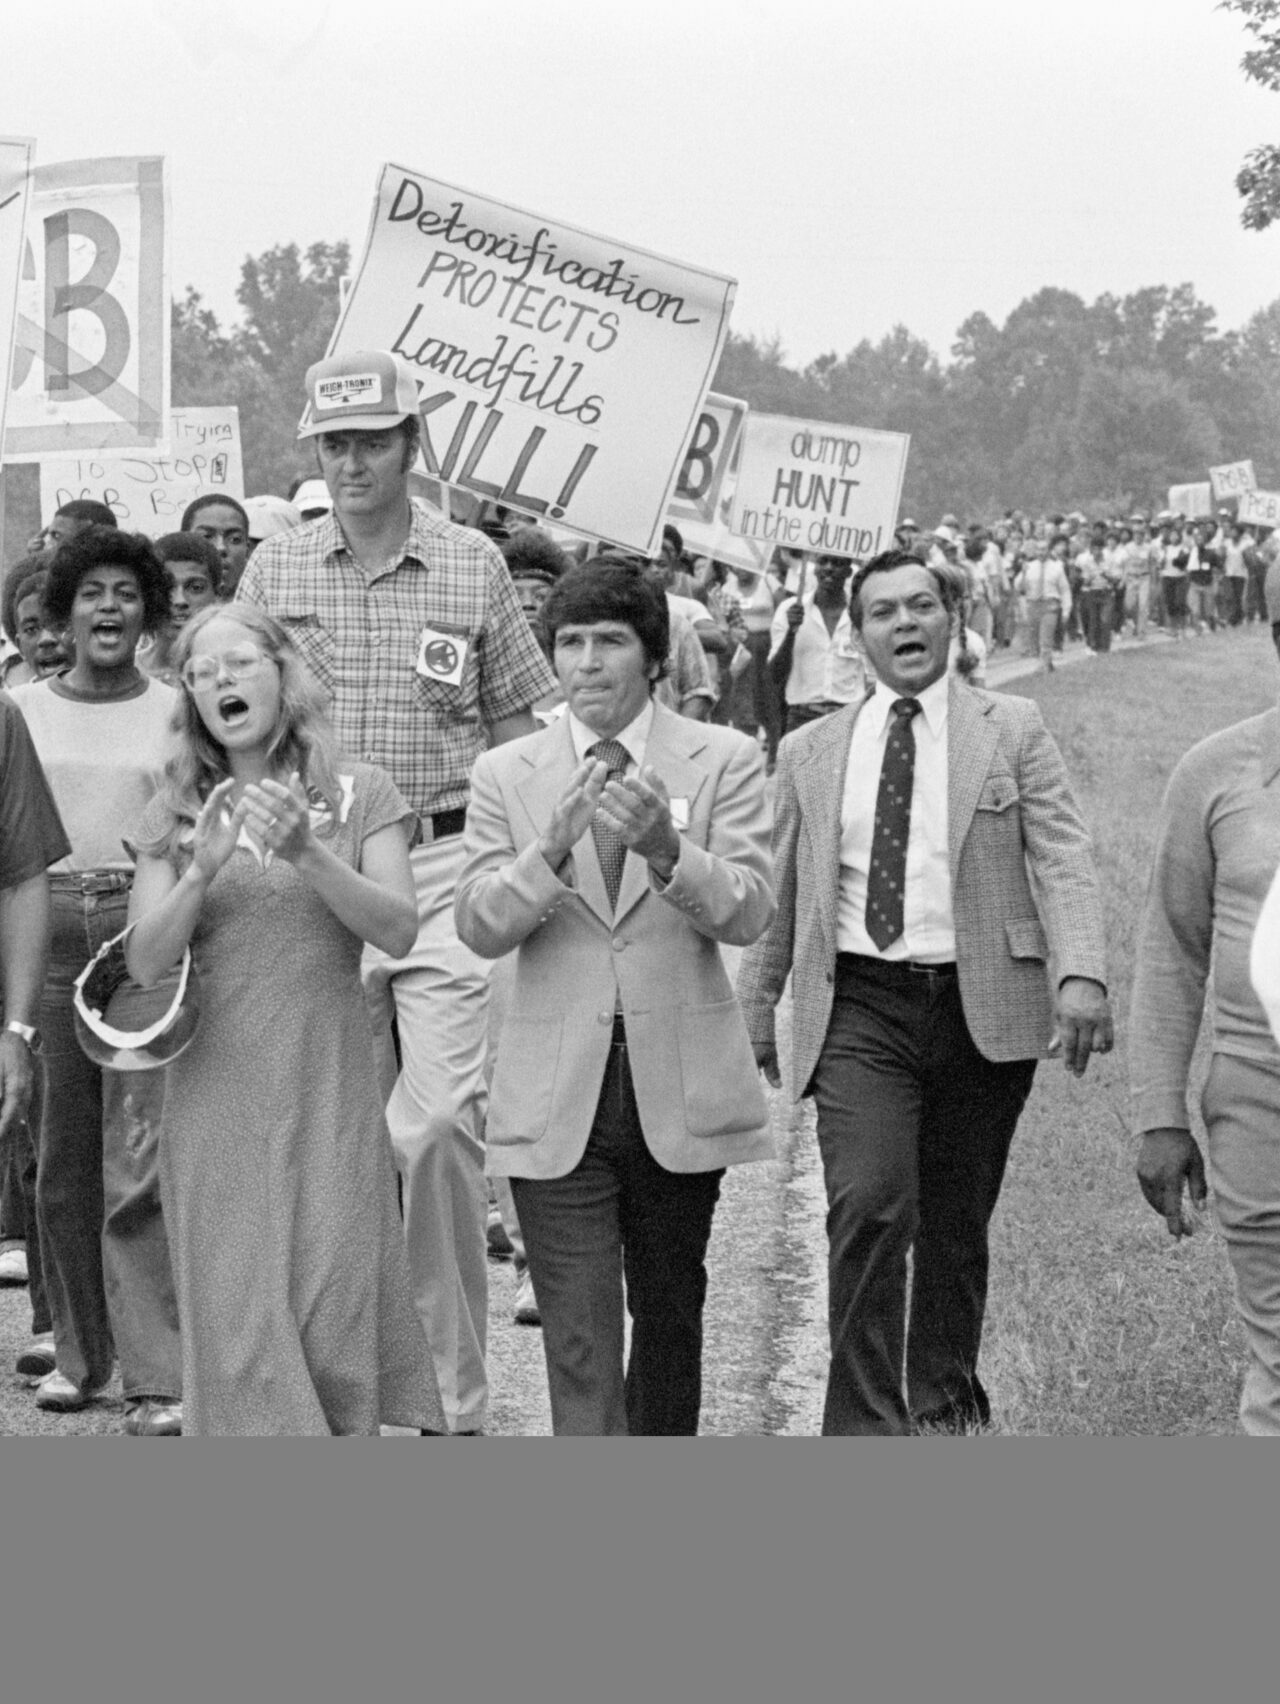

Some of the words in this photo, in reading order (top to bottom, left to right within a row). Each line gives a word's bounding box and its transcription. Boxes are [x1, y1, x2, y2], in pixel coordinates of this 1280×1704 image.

[388, 177, 701, 325] Detoxification
[417, 250, 620, 353] PROTECTS
[390, 303, 605, 425] Landfills
[120, 454, 208, 485] Stop
[415, 379, 599, 520] KILL!
[790, 428, 861, 477] dump
[740, 504, 759, 536] in
[762, 506, 801, 542] the
[807, 516, 883, 558] dump!
[771, 467, 861, 517] HUNT
